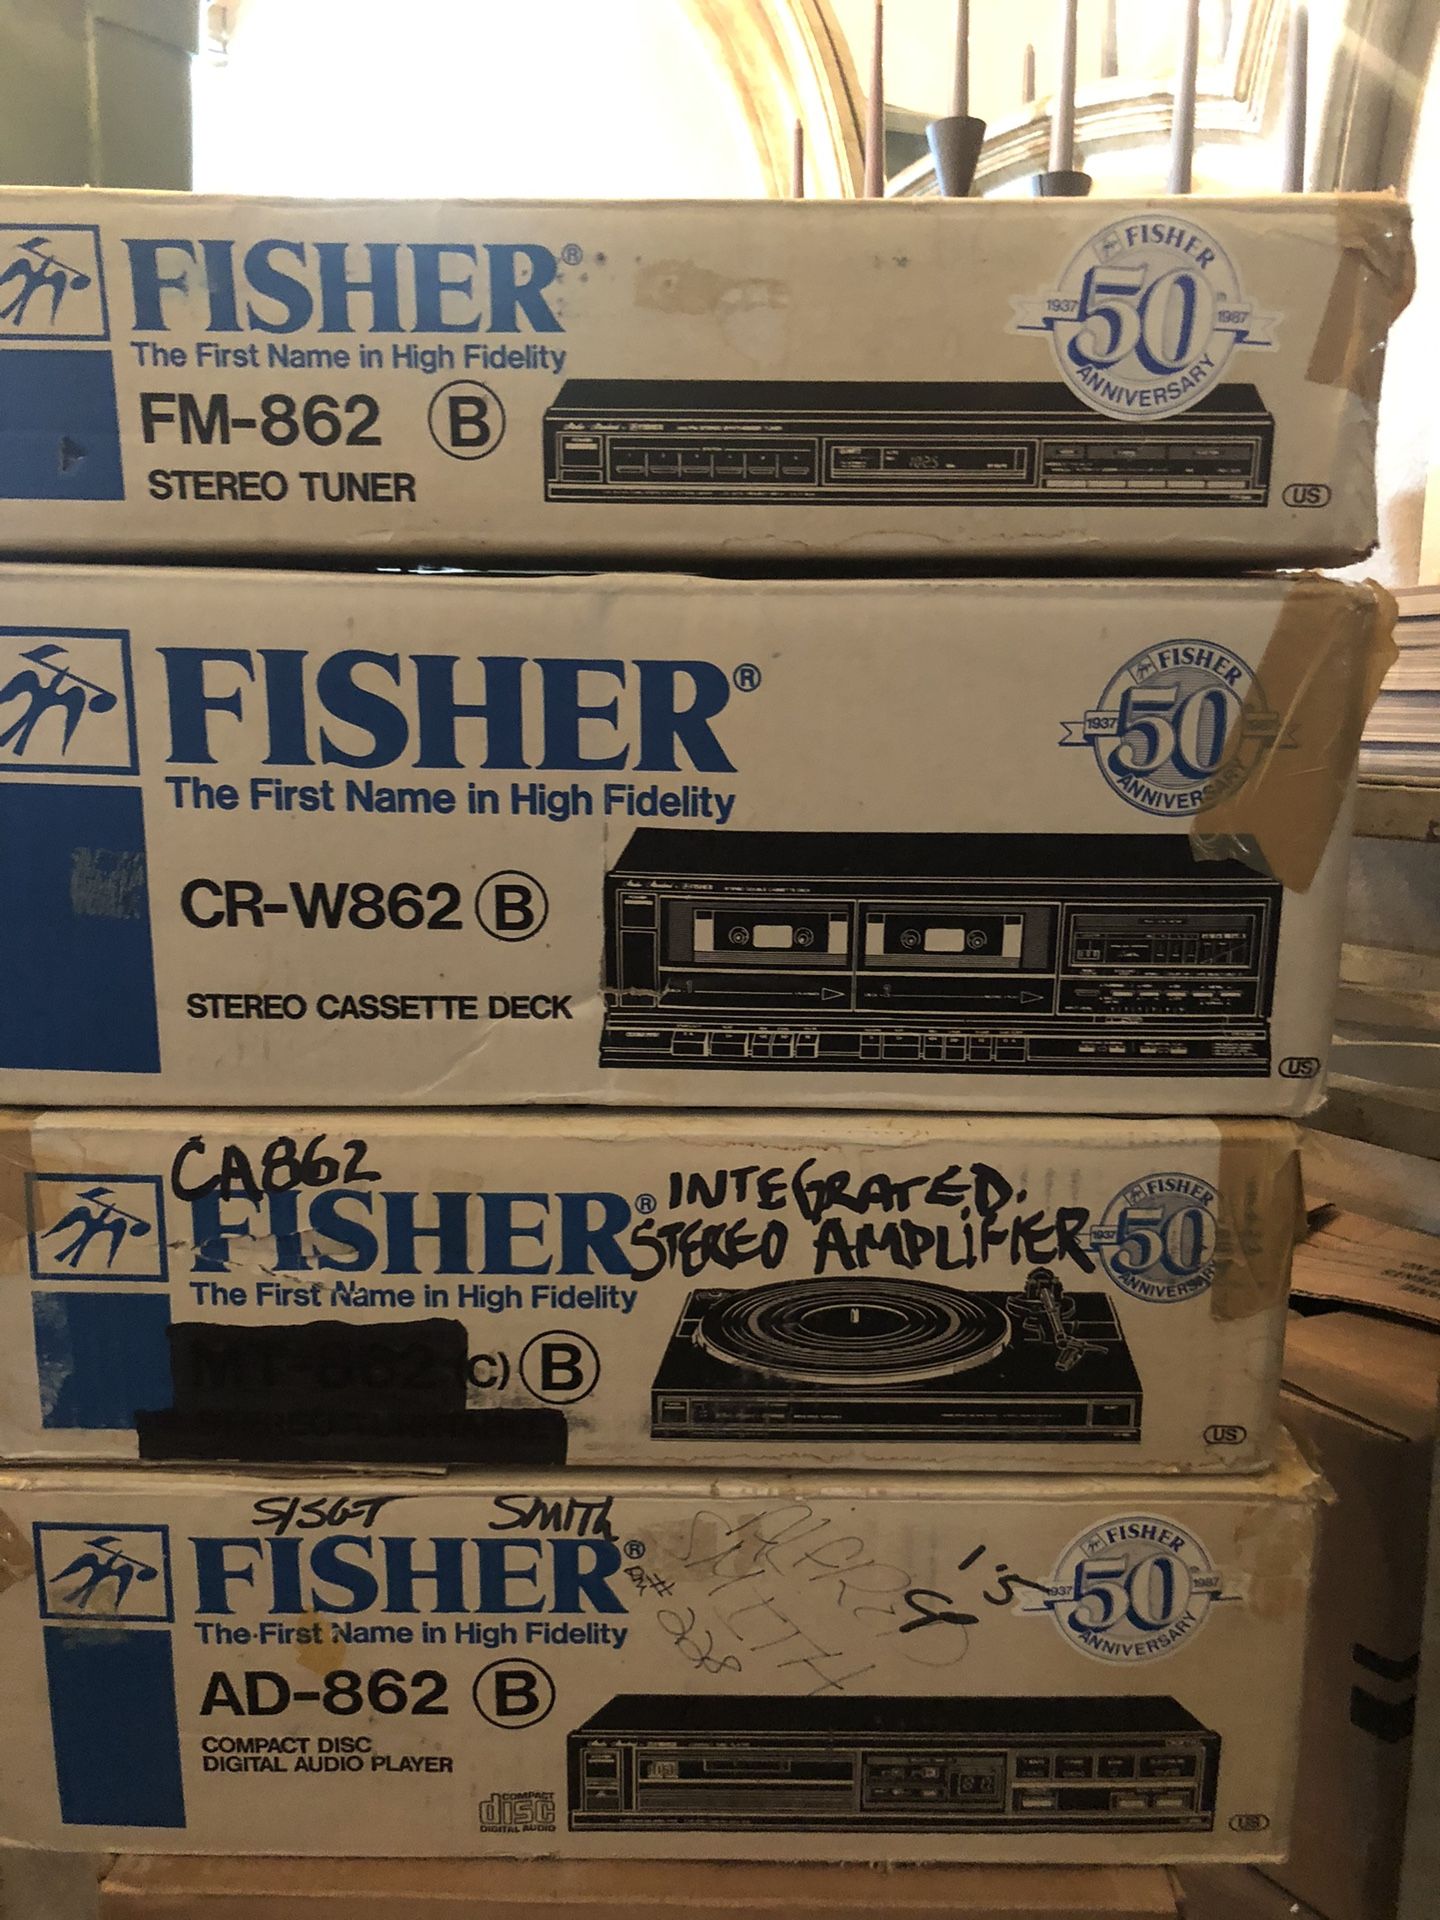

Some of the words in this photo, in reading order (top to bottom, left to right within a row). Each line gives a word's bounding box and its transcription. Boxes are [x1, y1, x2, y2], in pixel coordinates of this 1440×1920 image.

[1125, 224, 1215, 270] FISHER
[121, 239, 566, 334] FISHER
[1046, 299, 1078, 312] 1937
[1067, 264, 1208, 376] 50
[1217, 310, 1248, 323] 1987
[130, 341, 187, 367] The
[196, 342, 260, 368] First
[267, 343, 350, 369] Name
[360, 344, 383, 368] in
[392, 344, 454, 374] High
[464, 344, 566, 375] Fidelity
[1076, 354, 1216, 408] ANNIVERSARY
[140, 392, 381, 446] FM-862
[149, 469, 288, 501] STEREO
[299, 472, 416, 502] TUNER
[1158, 647, 1243, 686] FISHER
[156, 647, 738, 773] FISHER
[1086, 718, 1117, 729] 1937
[1108, 687, 1229, 779] 50
[165, 776, 239, 810] The
[251, 778, 335, 811] First
[346, 780, 456, 814] Name
[468, 783, 499, 814] in
[511, 783, 592, 822] High
[604, 784, 736, 824] Fidelity
[181, 879, 462, 930] CR-W862
[187, 993, 307, 1019] STEREO
[317, 994, 478, 1020] CASSETTE
[489, 995, 572, 1019] DECK
[171, 1135, 382, 1200] CA862
[1146, 1178, 1213, 1206] FISHER
[189, 1190, 639, 1275] FISHER
[631, 1218, 789, 1281] STEREO
[1111, 1207, 1216, 1276] 50
[189, 1282, 247, 1306] The
[256, 1282, 321, 1308] First
[331, 1282, 414, 1308] Name
[424, 1284, 448, 1307] in
[458, 1284, 522, 1313] High
[532, 1285, 637, 1314] Fidelity
[1106, 1524, 1185, 1553] FISHER
[188, 1534, 630, 1615] FISHER
[1068, 1555, 1191, 1633] 50
[195, 1622, 251, 1646] The
[259, 1623, 324, 1645] First
[331, 1623, 413, 1645] Name
[422, 1622, 446, 1644] in
[455, 1622, 517, 1648] High
[526, 1622, 628, 1649] Fidelity
[1078, 1611, 1198, 1656] ANNIVERSARY
[200, 1669, 448, 1715] AD-862
[202, 1736, 310, 1754] COMPACT
[318, 1736, 372, 1753] DISC
[203, 1756, 288, 1772] DIGITAL
[294, 1756, 364, 1772] AUDIO
[371, 1756, 453, 1773] PLAYER
[502, 1792, 554, 1800] COMPACT
[480, 1825, 520, 1833] DIGITAL
